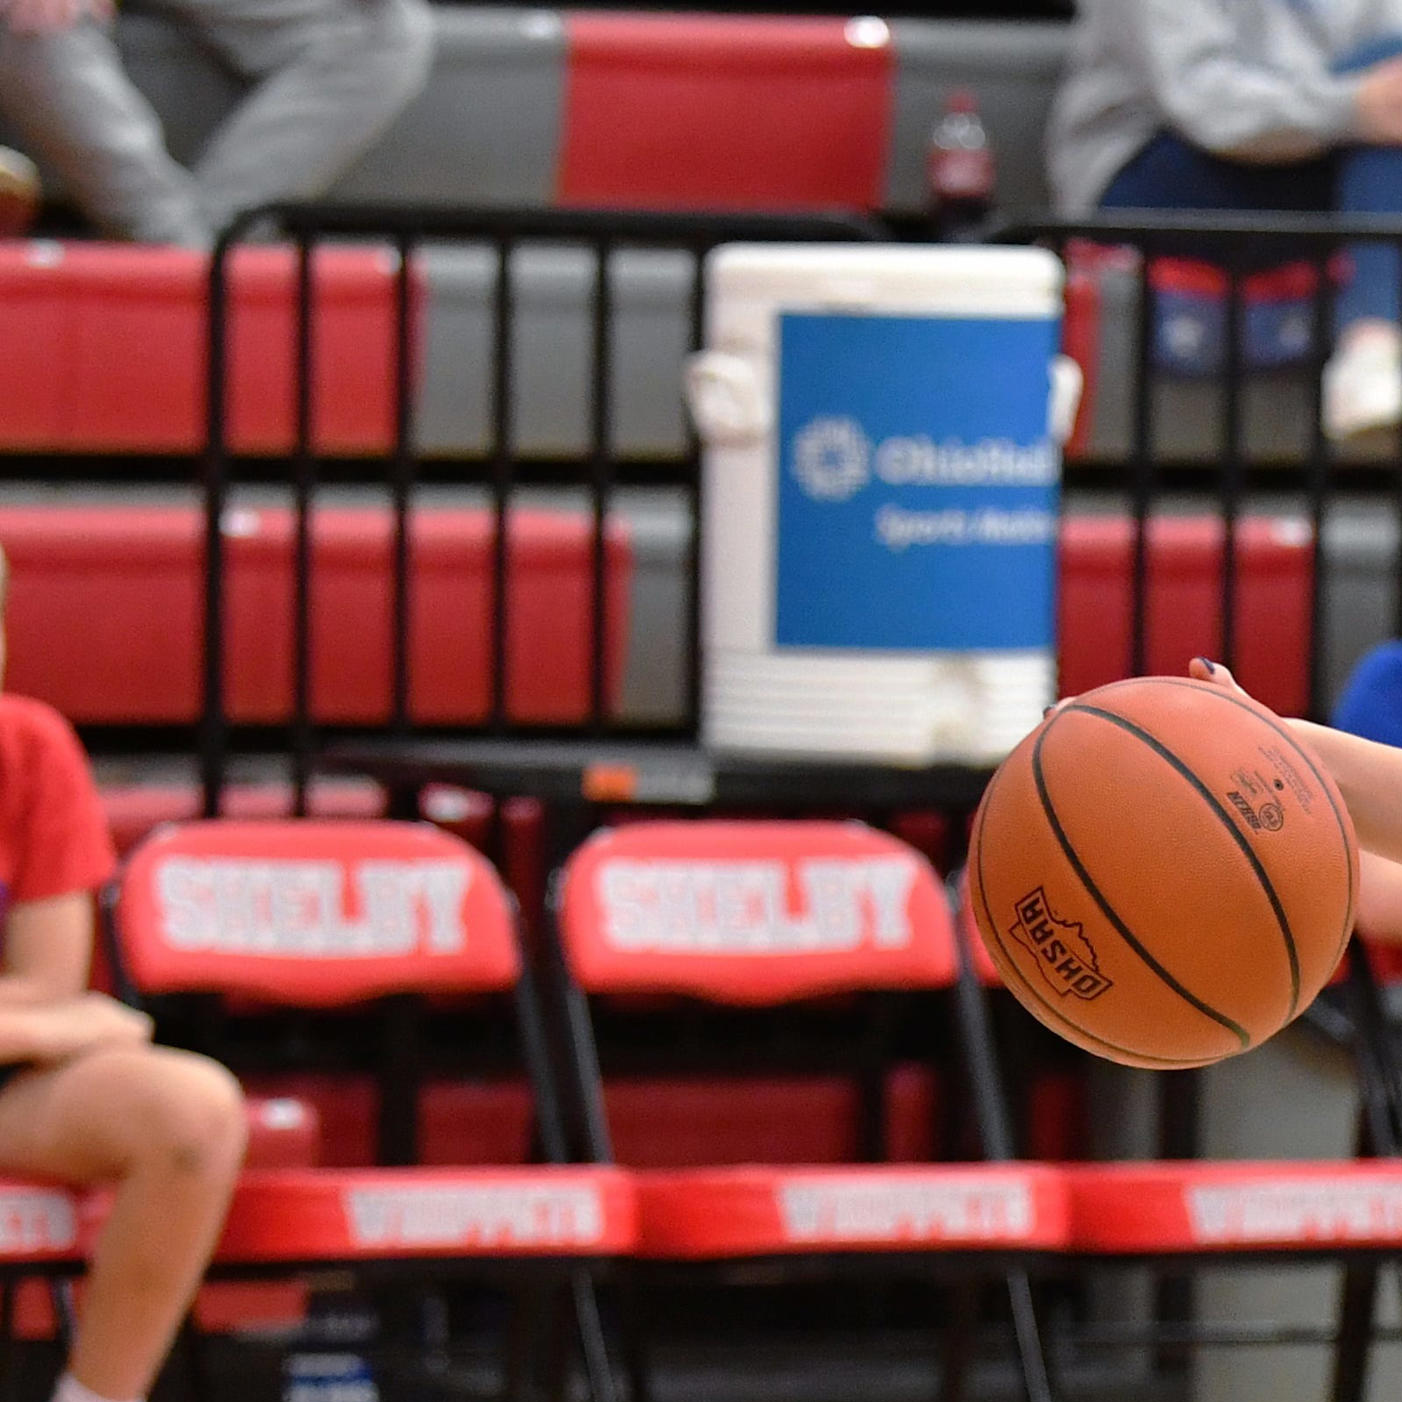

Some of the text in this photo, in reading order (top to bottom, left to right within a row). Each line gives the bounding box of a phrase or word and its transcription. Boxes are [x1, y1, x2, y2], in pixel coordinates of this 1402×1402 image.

[157, 854, 470, 956] SHELBY
[598, 855, 918, 954] SHELBY
[1020, 895, 1102, 995] OHSAA
